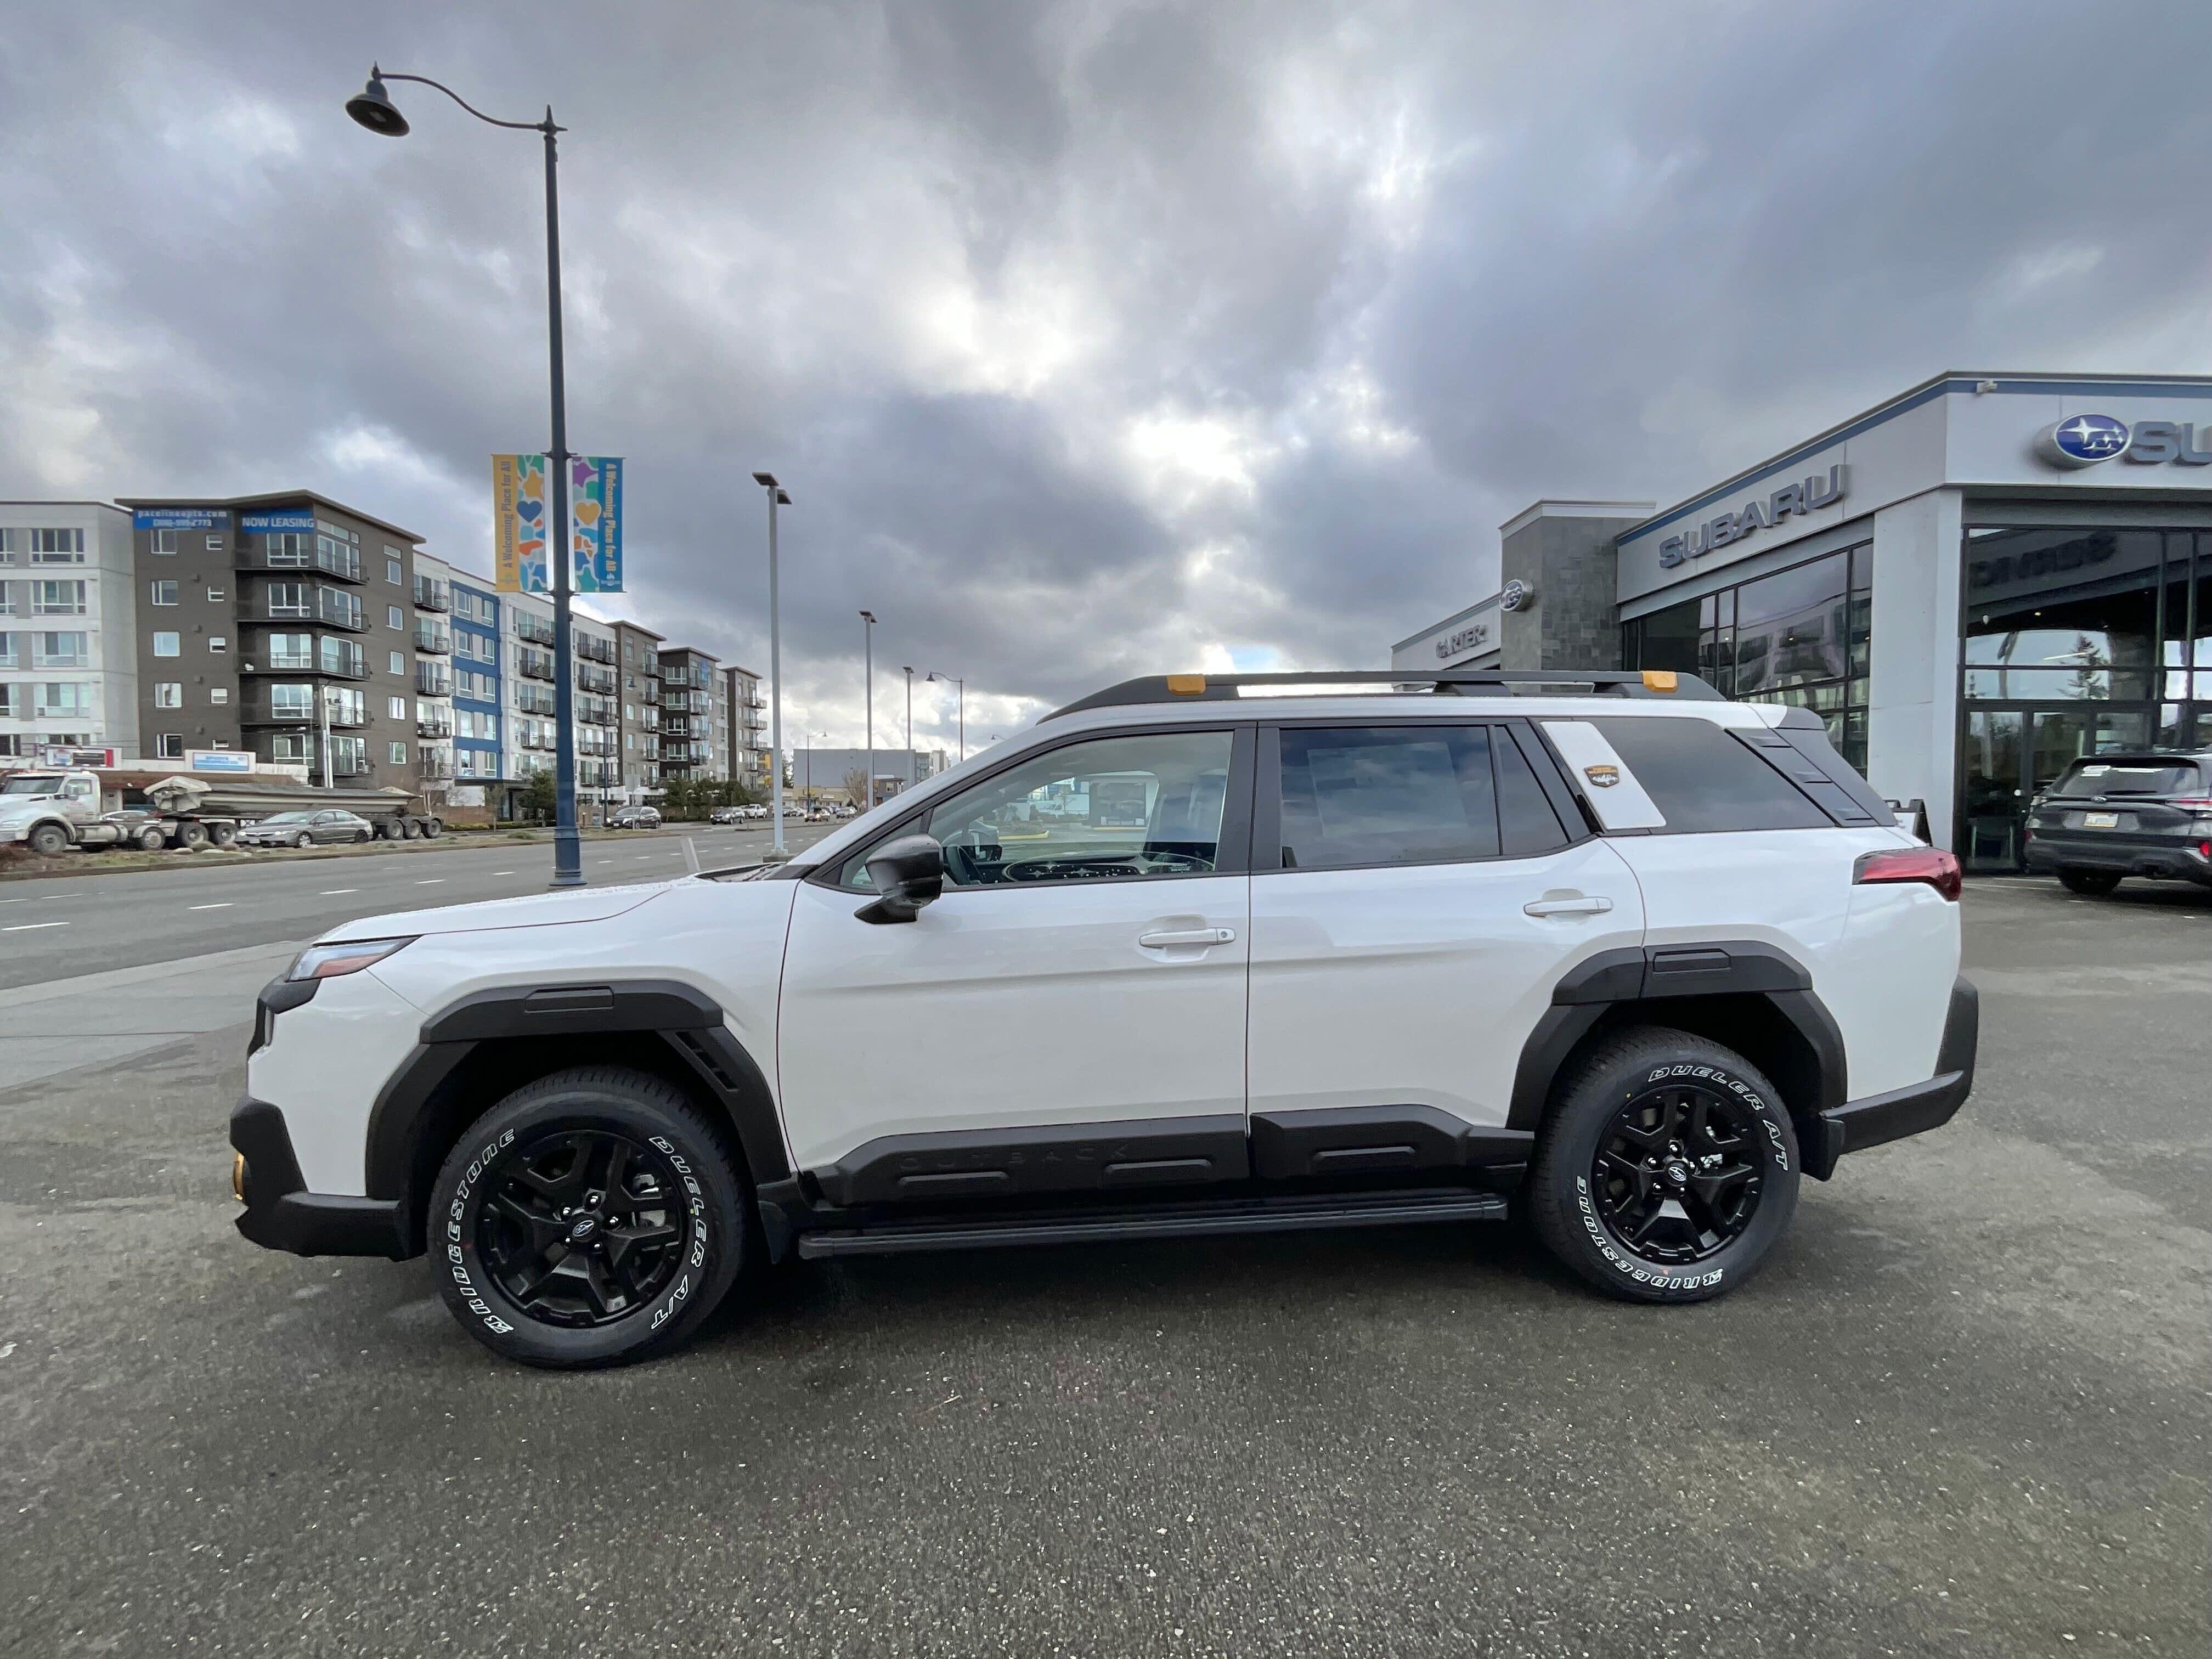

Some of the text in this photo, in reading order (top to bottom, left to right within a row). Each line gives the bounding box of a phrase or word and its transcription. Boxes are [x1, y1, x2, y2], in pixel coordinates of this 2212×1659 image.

[501, 461, 511, 472] All
[501, 473, 511, 486] for
[501, 489, 511, 511] Place
[603, 471, 617, 518] Welcoming
[242, 518, 314, 527] NOW LEASING
[605, 520, 616, 543] Place
[1659, 464, 1843, 568] SUBARU
[502, 514, 514, 561] Welcoming
[606, 545, 616, 558] for
[606, 560, 617, 571] All
[1436, 625, 1485, 658] CARTER
[1648, 1065, 1788, 1171] DUELER A/T
[448, 1128, 515, 1333] BRIDGESTONE
[649, 1136, 706, 1329] DUELER A/T
[1576, 1176, 1723, 1289] BRIDGESTONE
